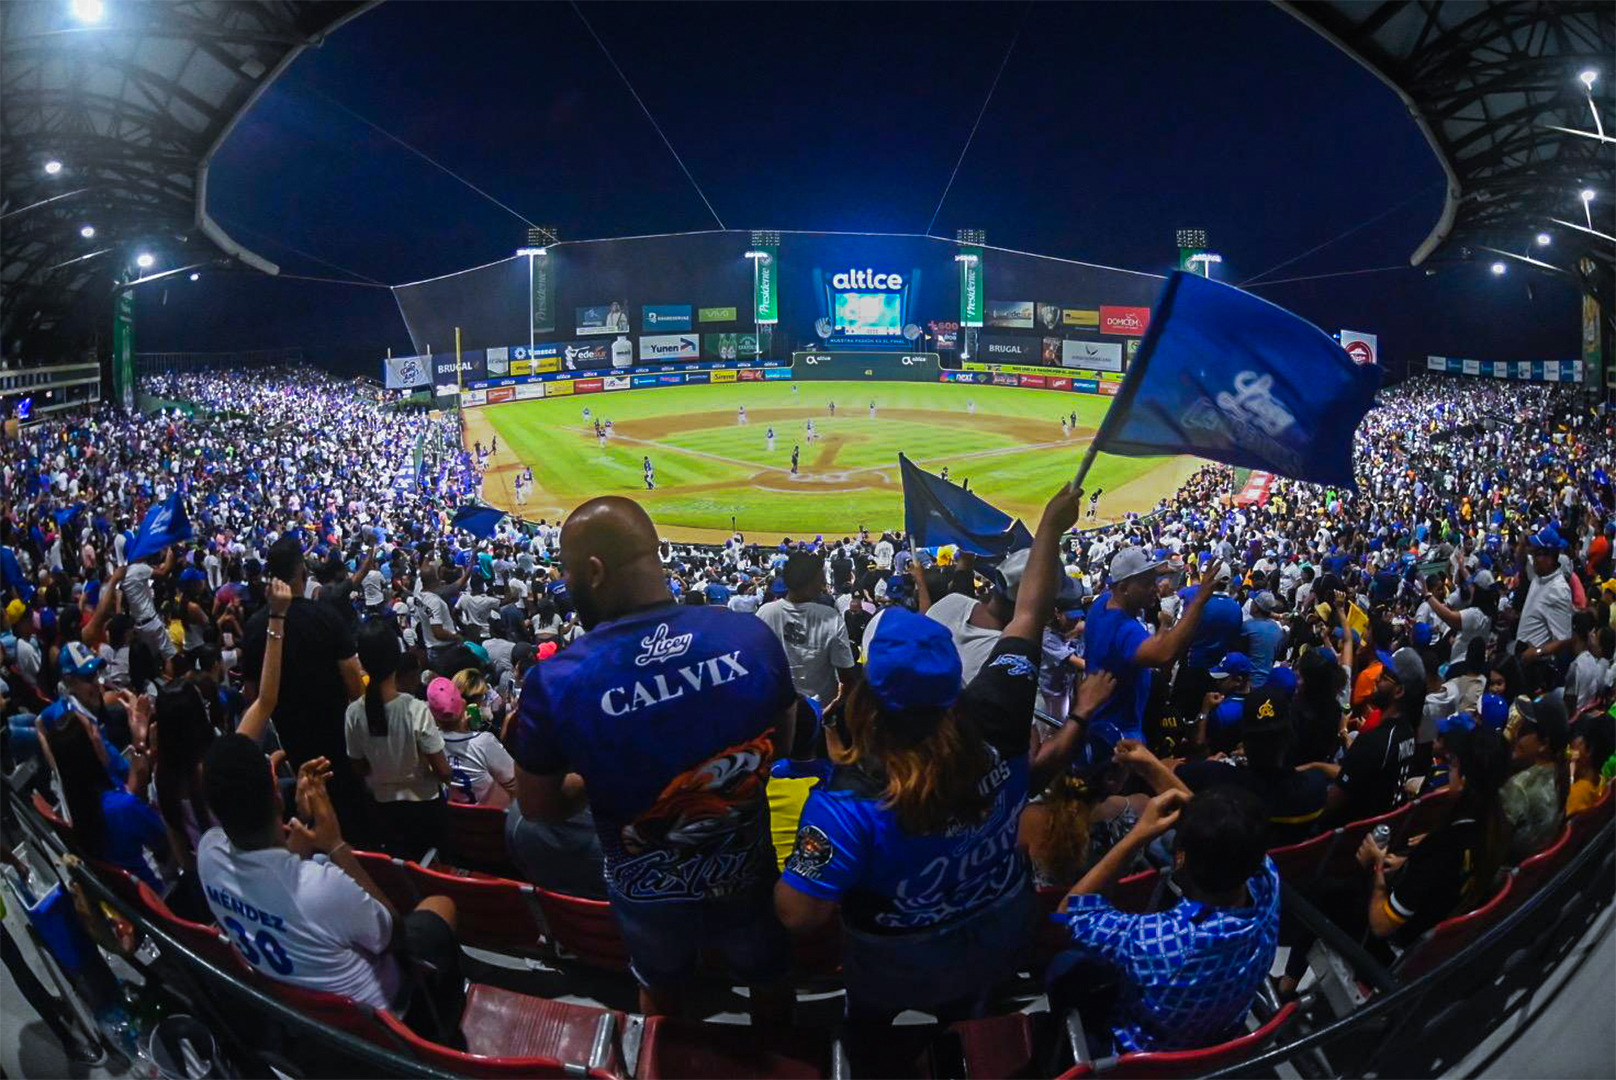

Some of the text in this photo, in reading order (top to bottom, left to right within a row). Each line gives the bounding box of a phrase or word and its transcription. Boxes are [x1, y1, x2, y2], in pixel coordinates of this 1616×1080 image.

[832, 268, 903, 290] altice
[759, 267, 770, 316] Presidente
[650, 345, 679, 354] Yunen
[989, 344, 1022, 354] BRUGAL
[437, 361, 473, 374] BRUGAL
[955, 373, 973, 382] next
[635, 622, 693, 666] Licey
[600, 650, 749, 716] CALVIX
[224, 915, 295, 976] 30
